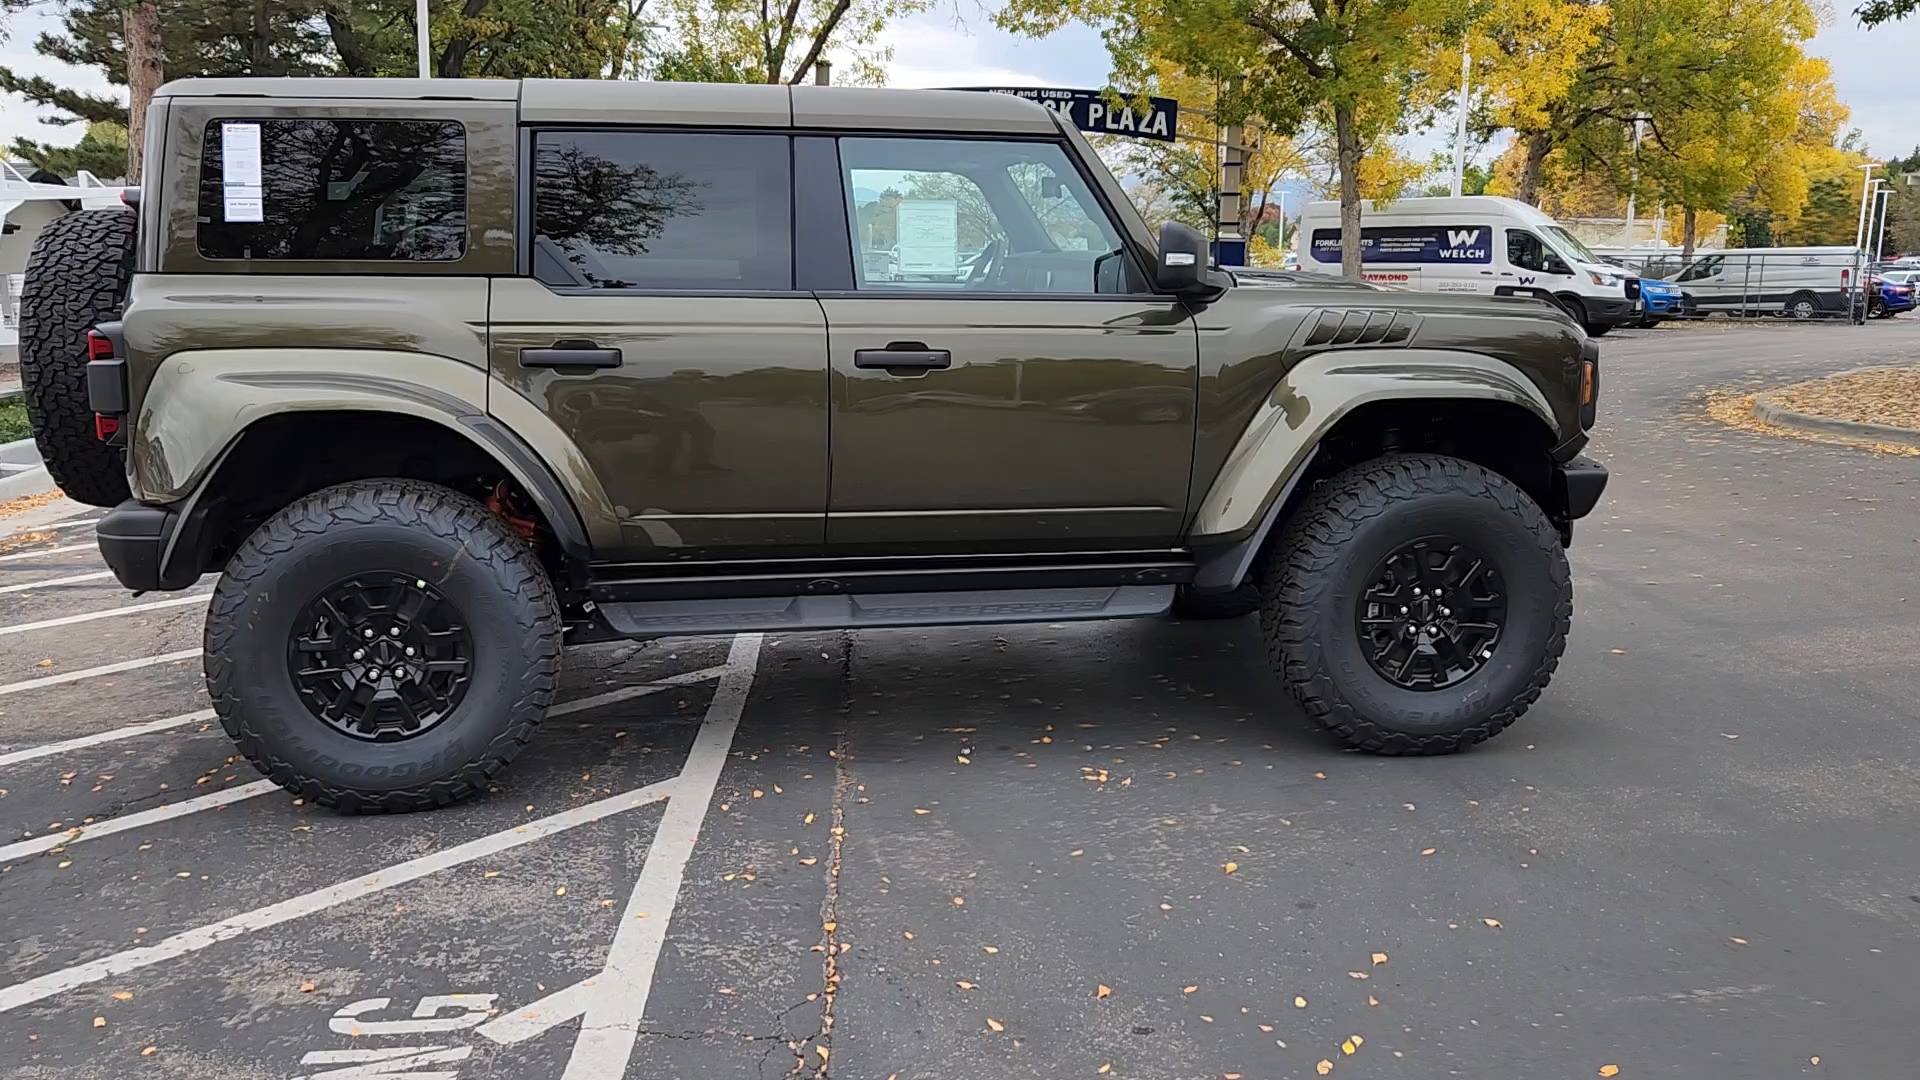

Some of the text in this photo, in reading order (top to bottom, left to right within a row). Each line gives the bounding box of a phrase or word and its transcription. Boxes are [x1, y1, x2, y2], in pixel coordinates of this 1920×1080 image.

[1041, 90, 1072, 99] USED
[1088, 103, 1168, 136] PLAZA
[1315, 239, 1342, 247] FORKLI
[1439, 249, 1485, 259] WELCH
